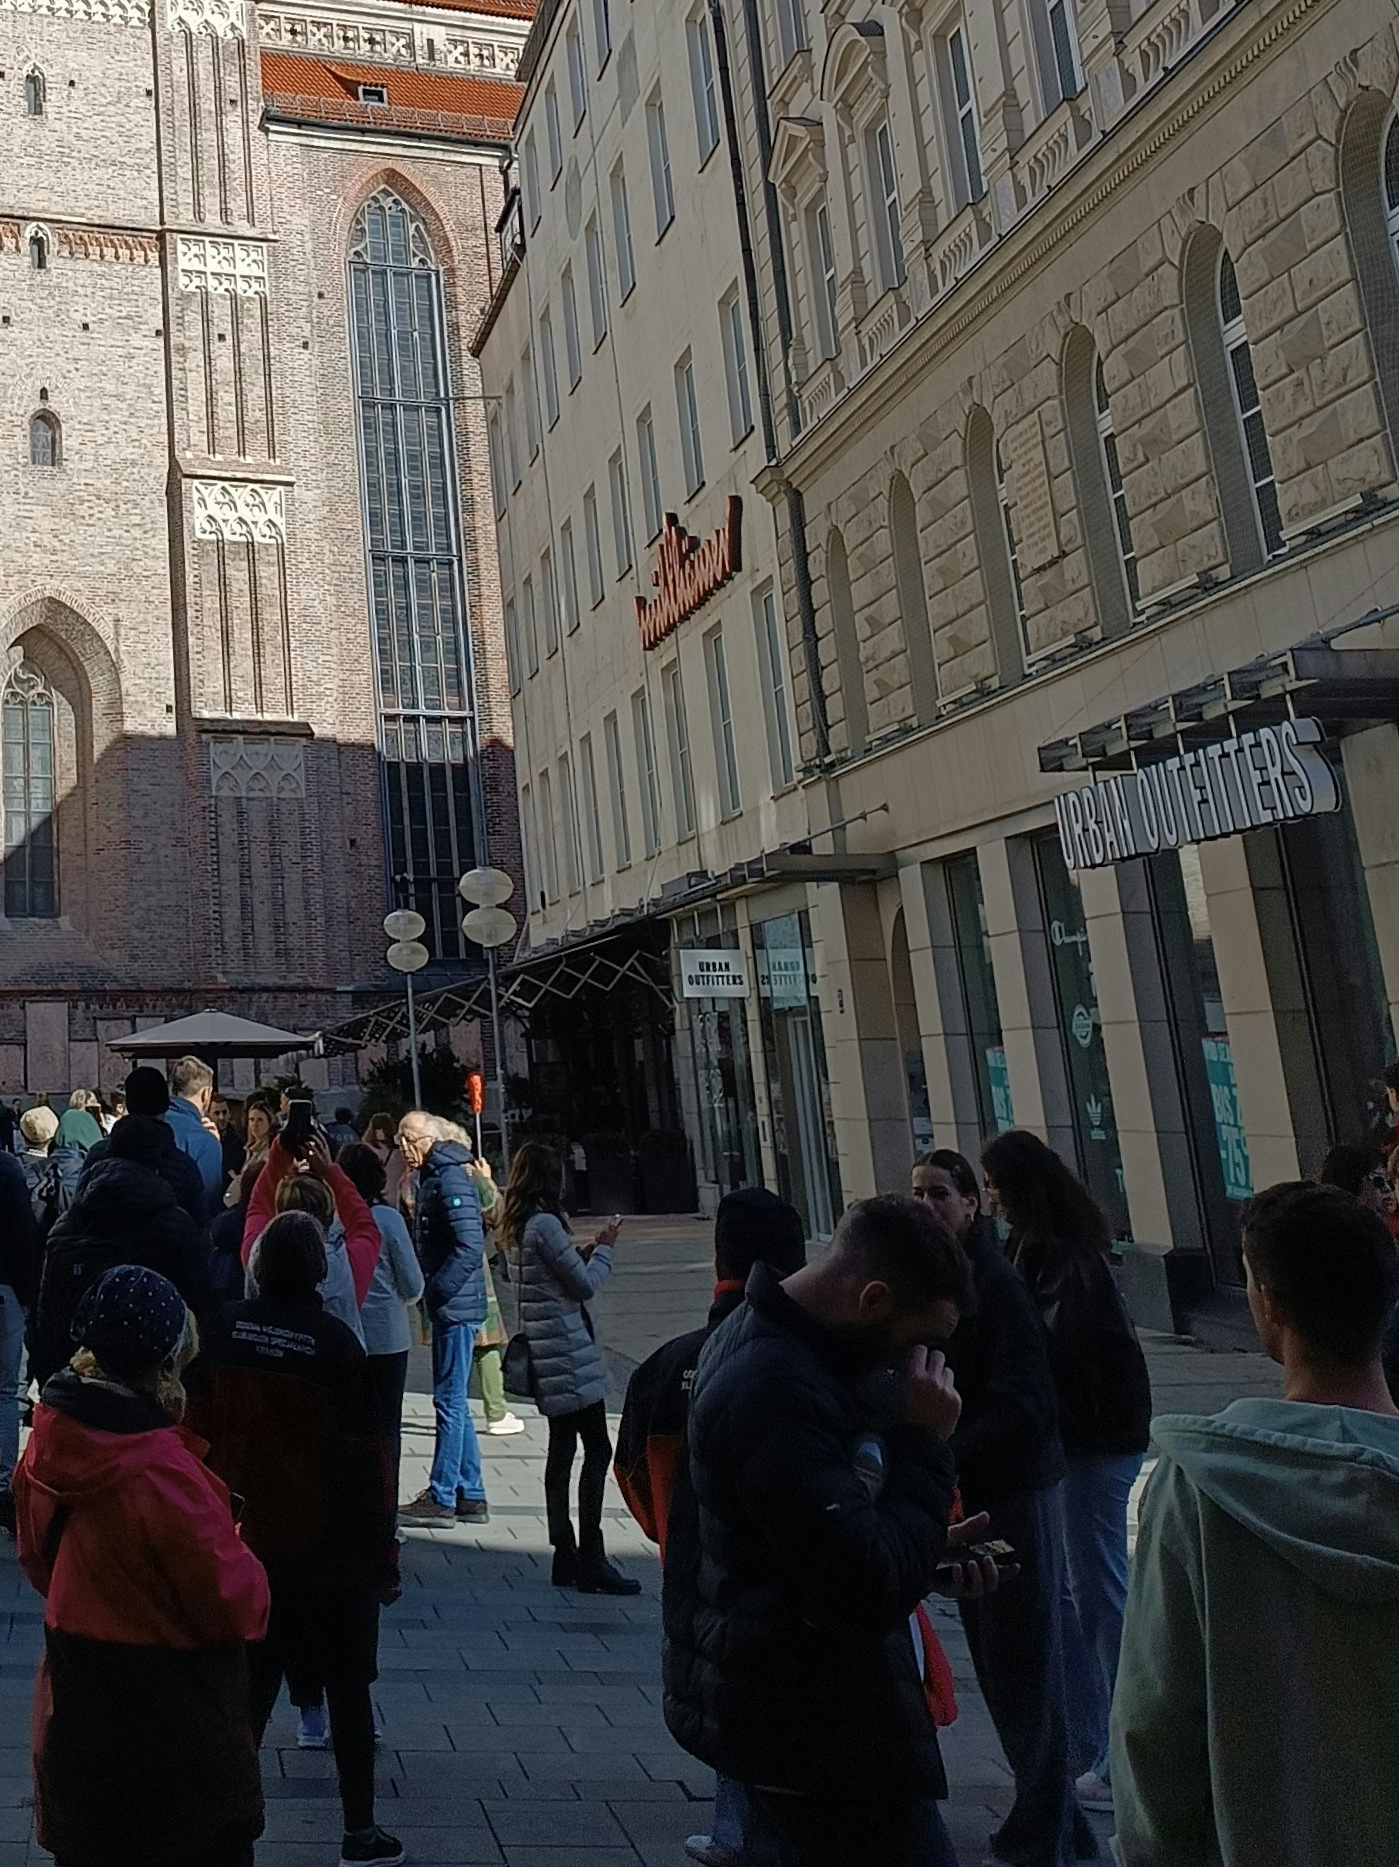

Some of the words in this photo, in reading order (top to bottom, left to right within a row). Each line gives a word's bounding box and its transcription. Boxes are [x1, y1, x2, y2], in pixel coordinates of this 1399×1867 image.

[1054, 775, 1137, 870] URBAN
[1137, 717, 1324, 850] OUTFITTERS
[698, 960, 730, 972] URBAN
[688, 974, 744, 986] OUTFITTERS
